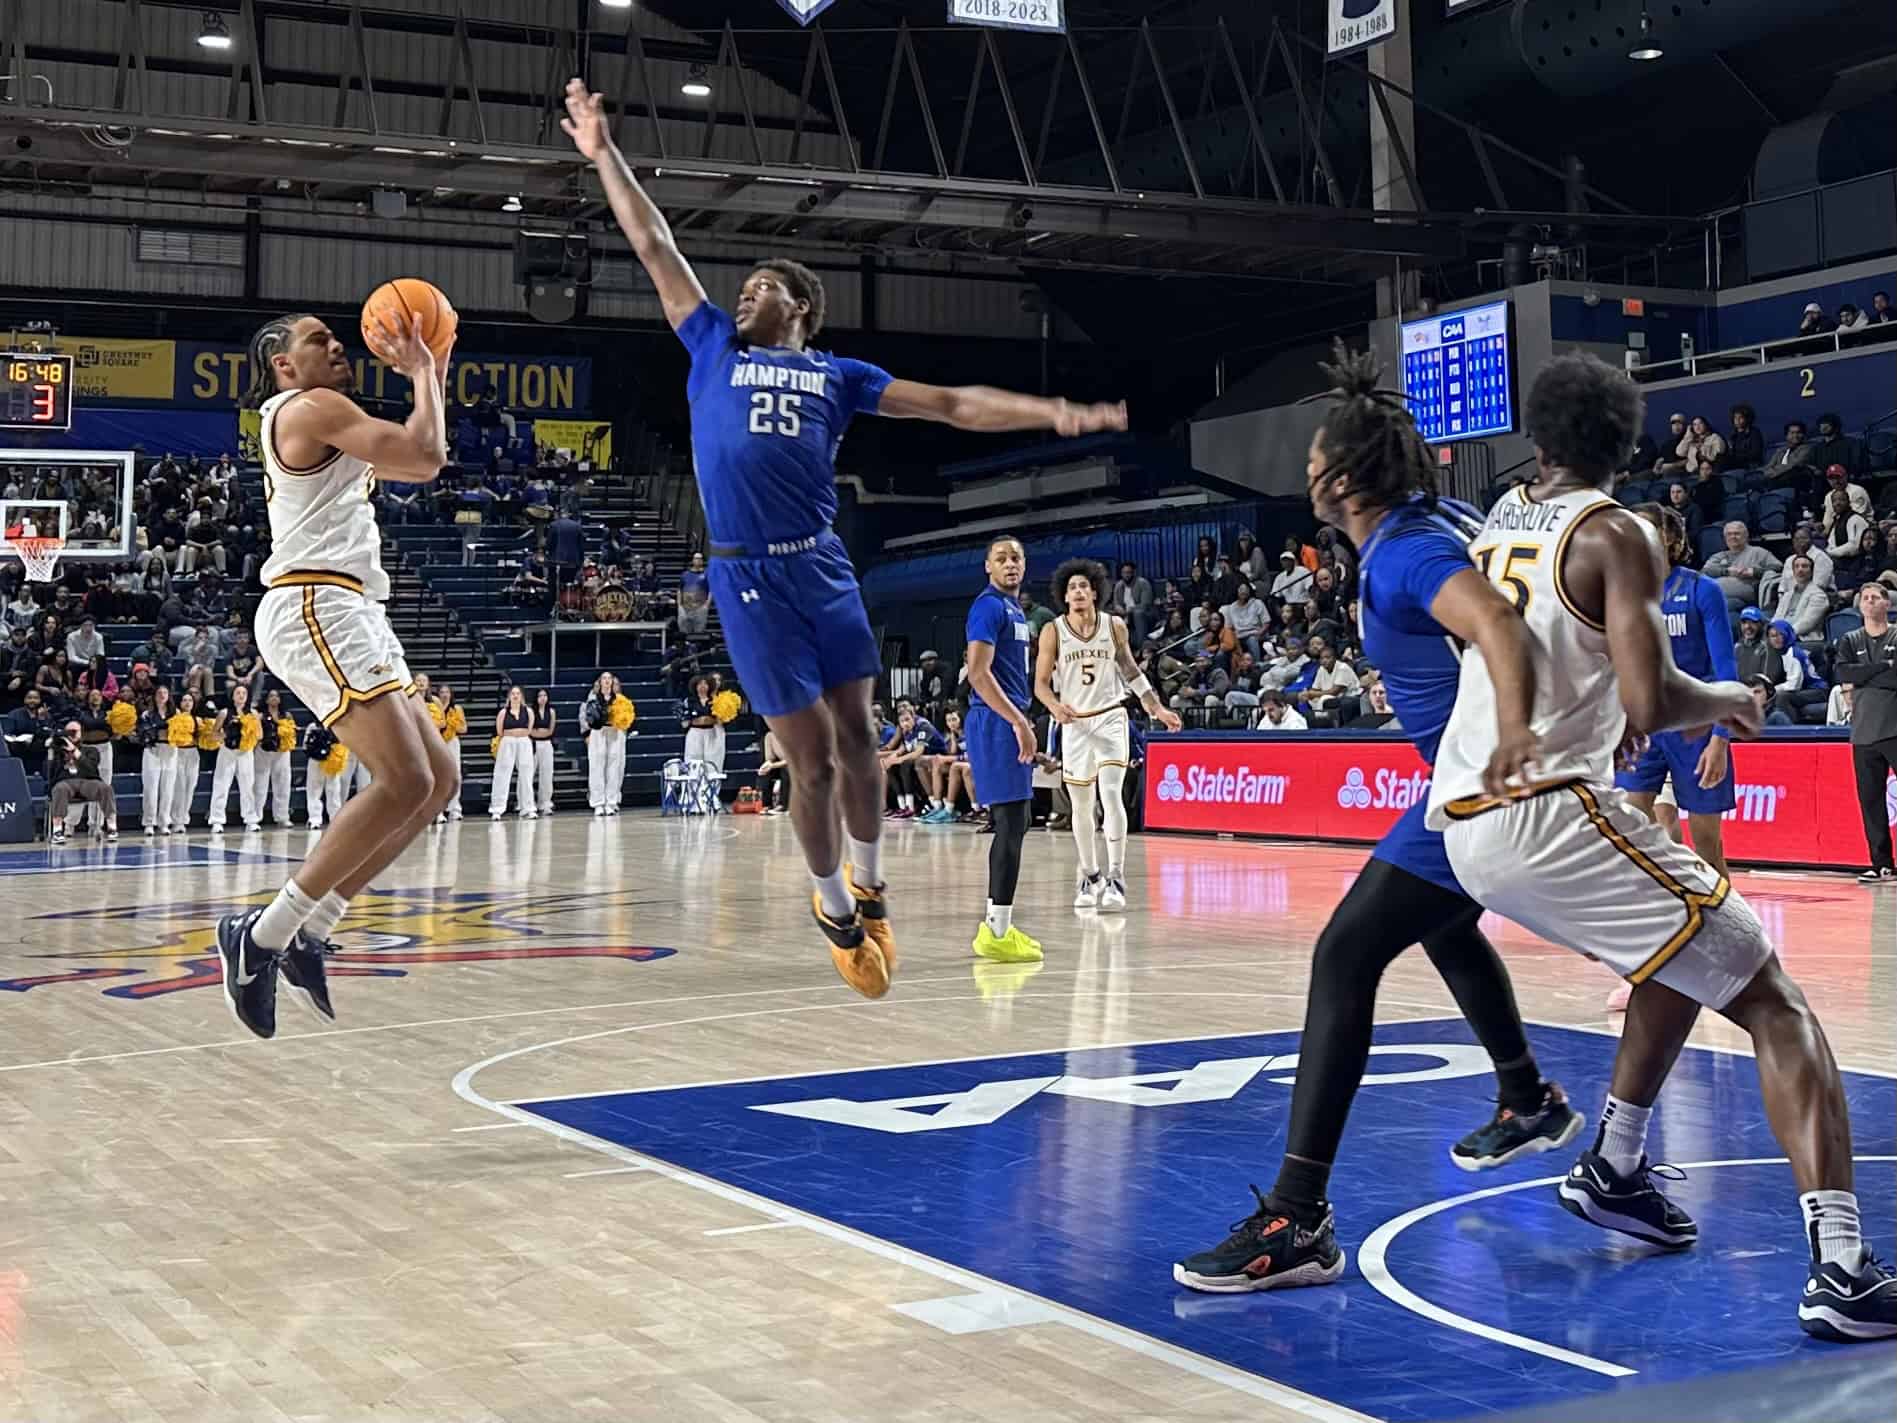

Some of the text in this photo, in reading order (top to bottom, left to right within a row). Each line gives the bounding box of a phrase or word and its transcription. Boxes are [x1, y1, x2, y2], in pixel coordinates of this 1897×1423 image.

[965, 0, 1048, 21] 2018-2023
[1335, 13, 1388, 46] 1984-1988
[8, 363, 63, 383] 16:48
[730, 362, 826, 397] HAMPTON
[1800, 368, 1816, 397] 2
[32, 384, 54, 421] 3
[749, 391, 801, 436] 25
[1065, 648, 1110, 662] DREXEL
[1081, 664, 1095, 686] 5
